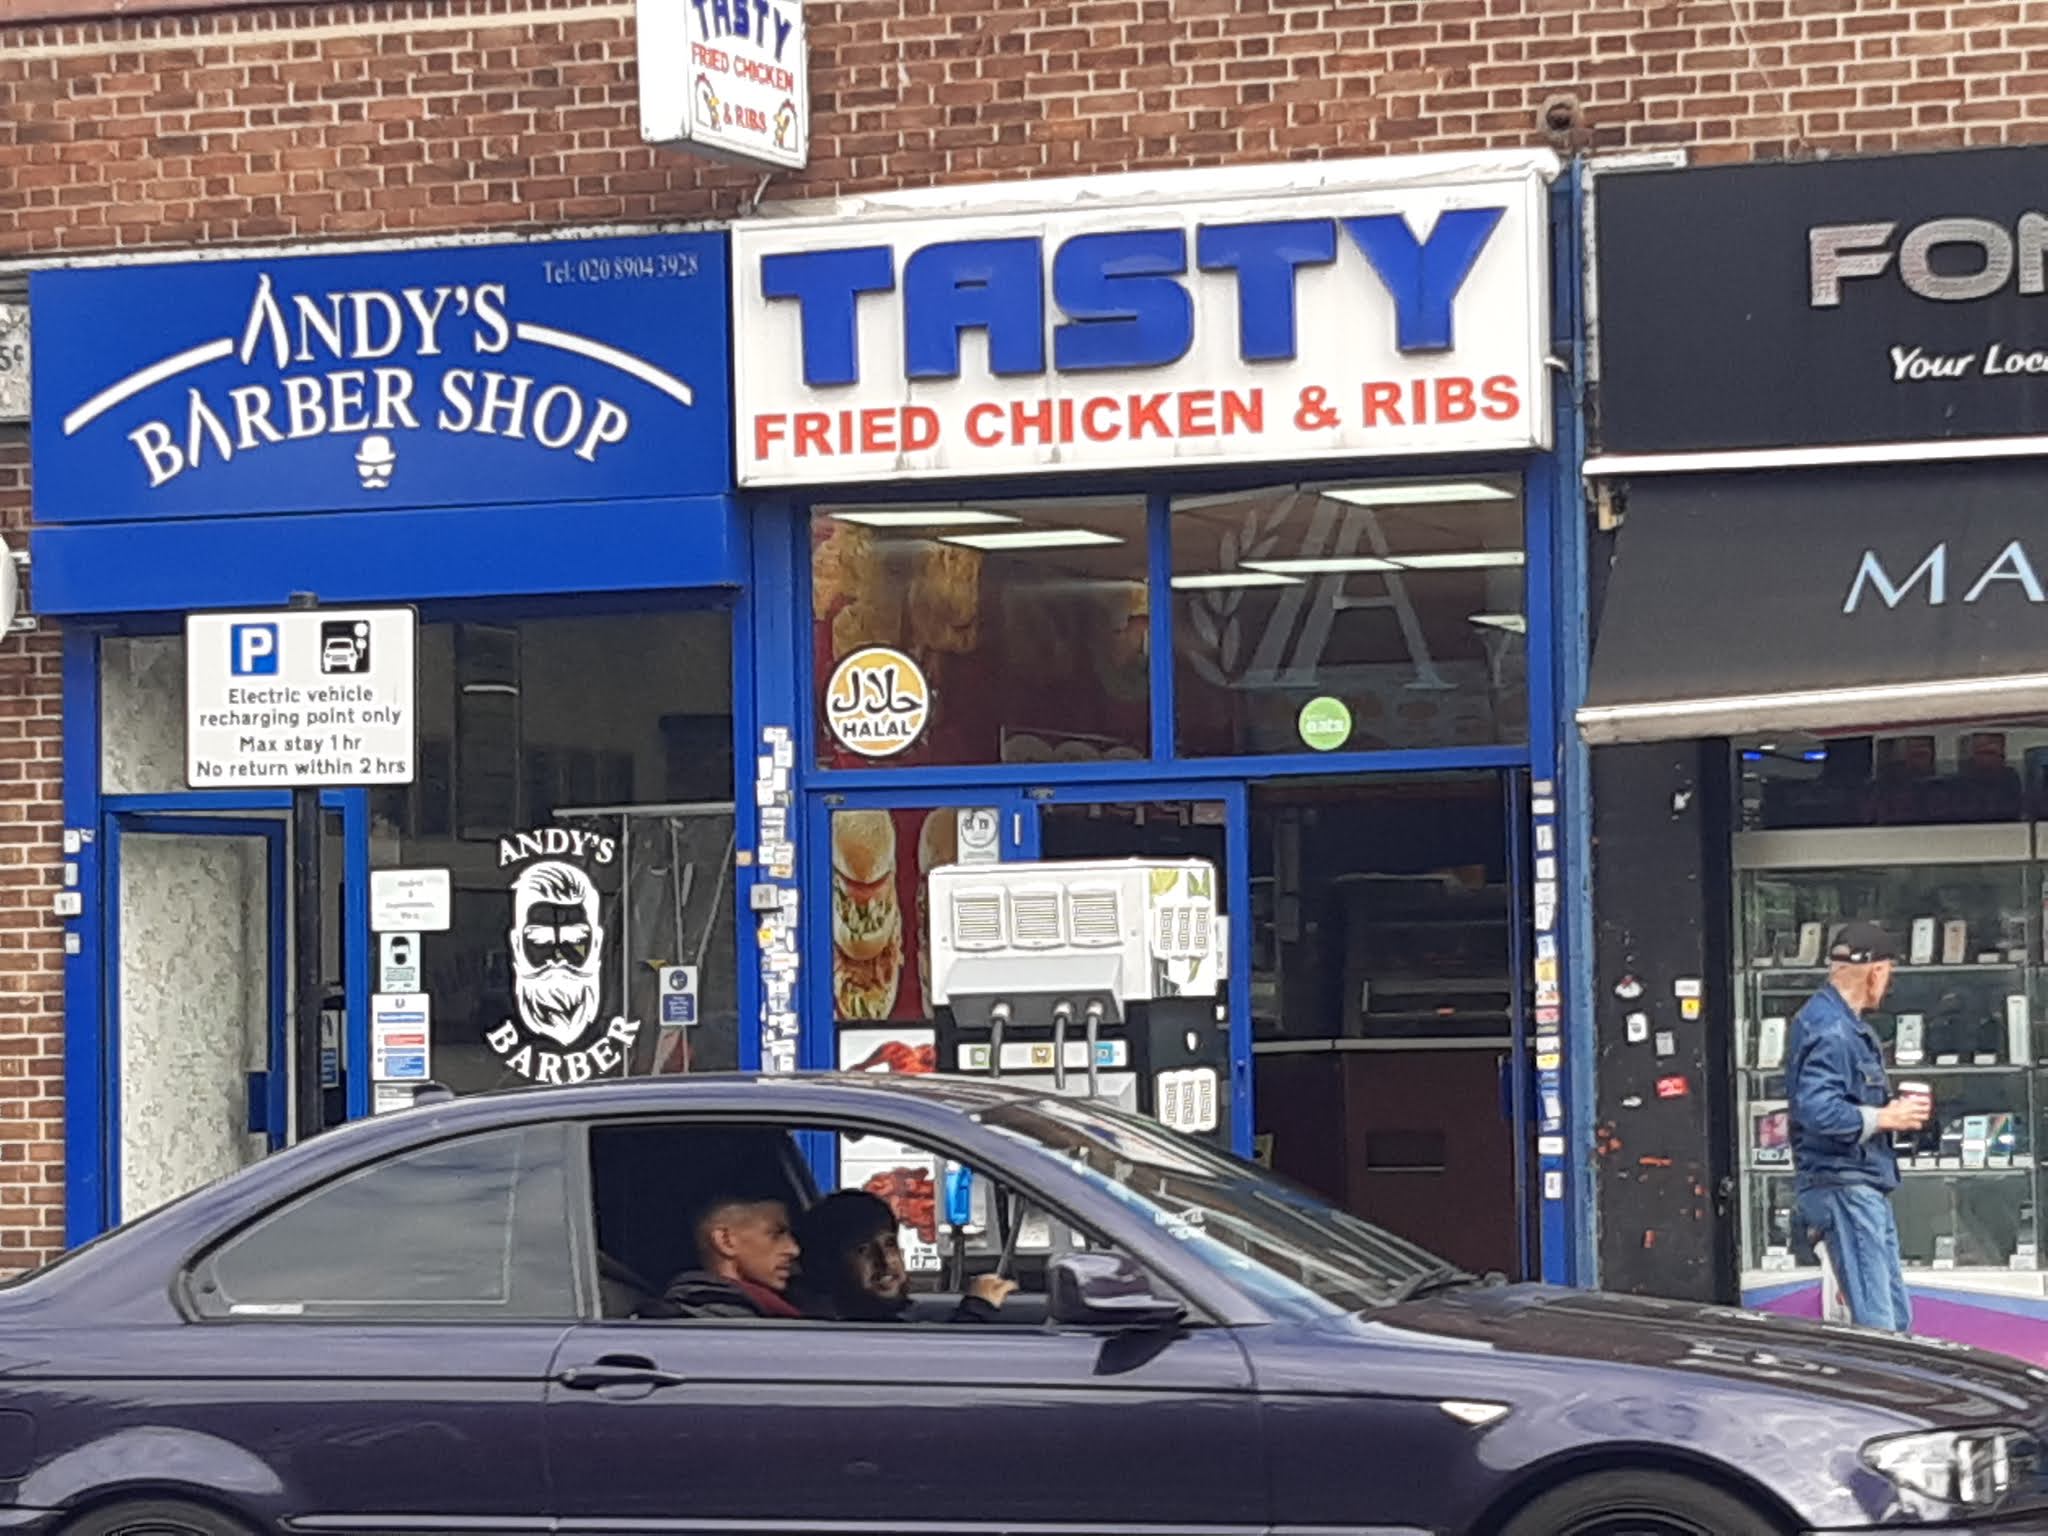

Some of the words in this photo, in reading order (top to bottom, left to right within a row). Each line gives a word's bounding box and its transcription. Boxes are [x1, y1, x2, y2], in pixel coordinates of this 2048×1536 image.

[690, 0, 792, 62] TASTY
[691, 41, 730, 73] FRIED
[734, 55, 793, 95] CHICKEN
[723, 102, 733, 125] &
[735, 104, 767, 134] RIBS
[544, 260, 576, 284] Tel:
[579, 258, 610, 281] 020
[614, 255, 654, 280] 8904
[657, 252, 699, 277] 3928
[760, 206, 1508, 387] TASTY
[240, 272, 511, 369] ANDY'S
[1889, 345, 1974, 381] Your
[1983, 344, 2048, 377] Loc
[128, 367, 415, 487] BARBER
[438, 368, 629, 463] SHOP
[753, 404, 940, 460] FRIED
[964, 387, 1264, 449] CHICKEN
[1295, 385, 1341, 430] &
[1362, 374, 1521, 428] RIBS
[241, 627, 273, 673] P
[228, 687, 300, 704] Electric
[307, 686, 373, 702] vehicle
[832, 668, 923, 714] حلال
[200, 709, 299, 728] recharging
[307, 708, 355, 725] point
[362, 707, 402, 725] only
[842, 719, 911, 738] HALAL
[239, 736, 277, 753] Max
[284, 735, 323, 754] stay
[197, 761, 222, 777] No
[230, 761, 288, 777] return
[296, 759, 352, 776] within
[359, 758, 372, 774] 2
[376, 757, 406, 774] hrs
[499, 828, 616, 867] ANDY'S
[487, 1016, 641, 1085] BARBER
